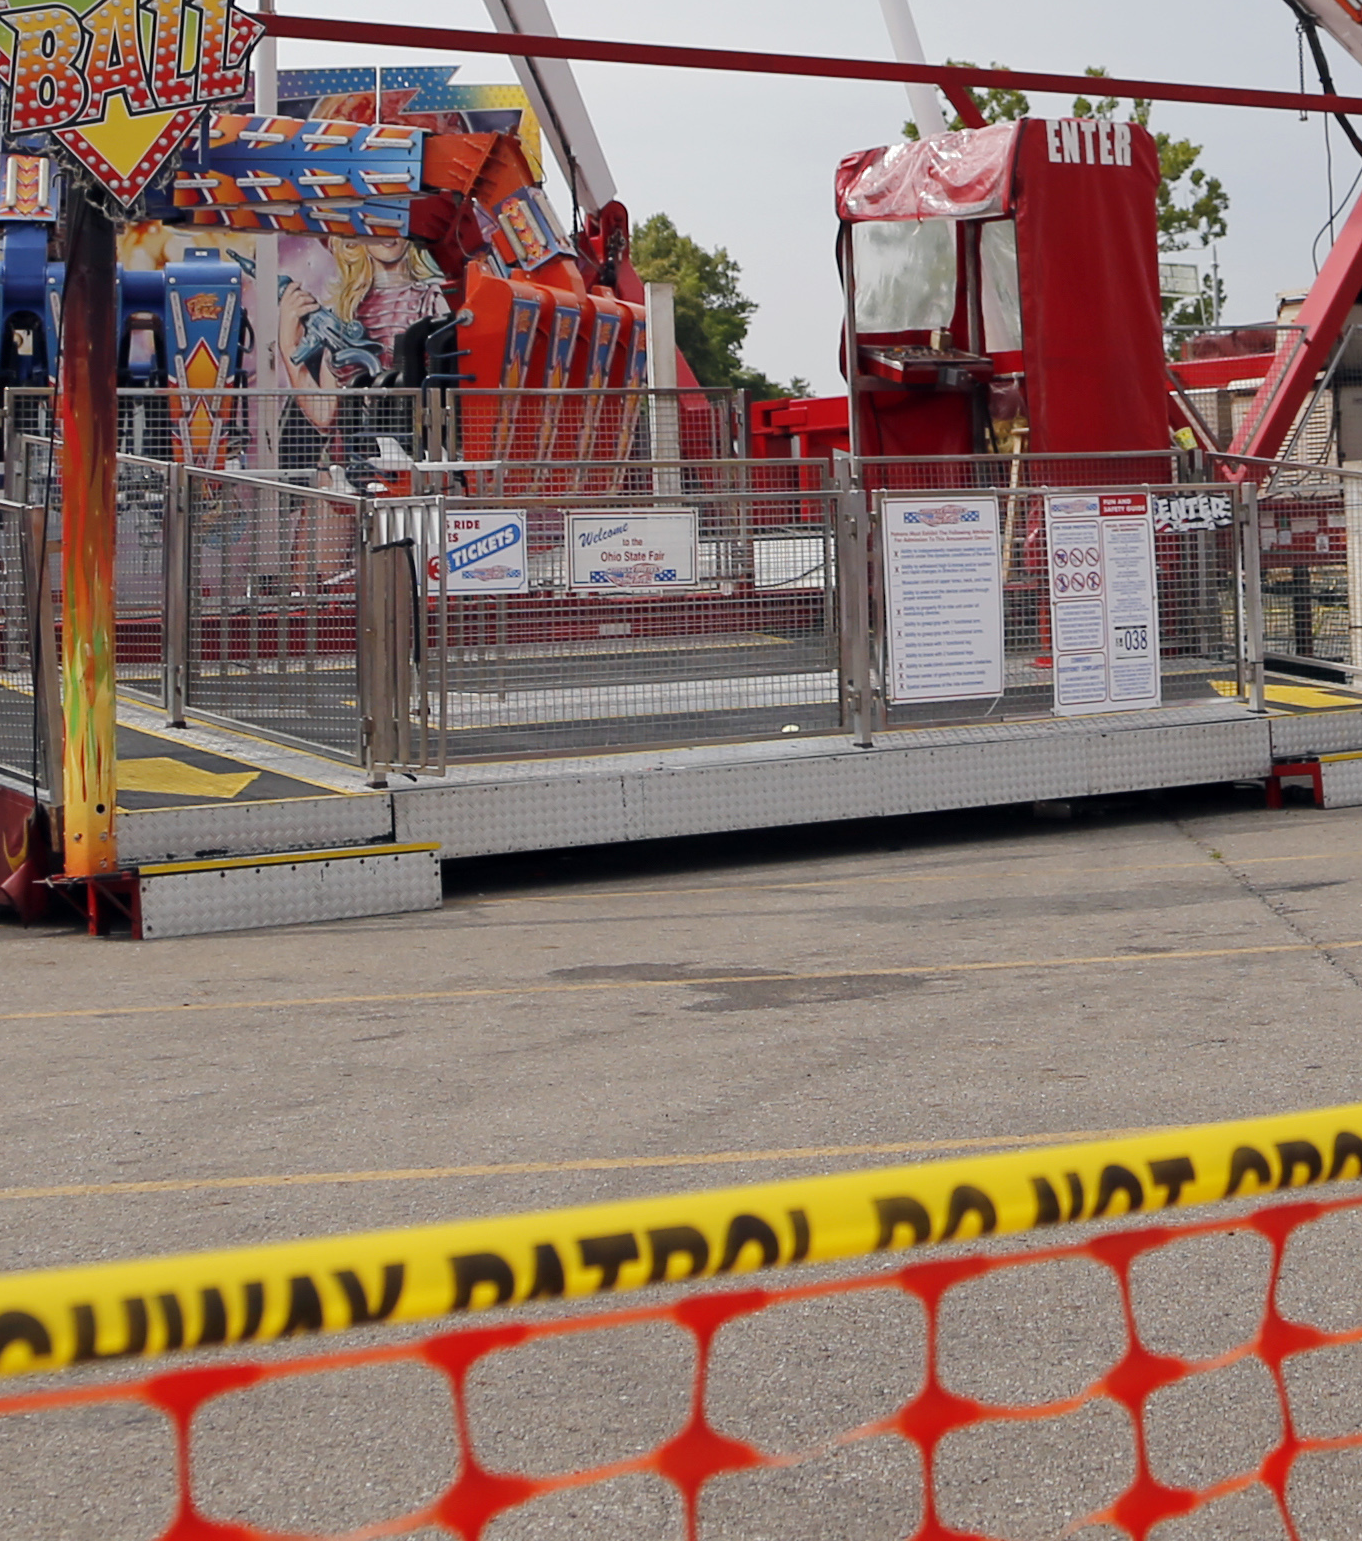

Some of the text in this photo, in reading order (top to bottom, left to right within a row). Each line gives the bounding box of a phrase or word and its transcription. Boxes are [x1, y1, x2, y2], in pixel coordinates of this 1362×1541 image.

[1046, 120, 1132, 166] ENTER
[1103, 505, 1125, 513] SAFETY
[1117, 497, 1132, 505] AND
[1157, 496, 1226, 520] ENTER
[454, 520, 480, 530] RIDE
[578, 522, 628, 547] Welcome
[622, 538, 643, 546] to the
[452, 527, 515, 567] TICKETS
[601, 550, 665, 562] Ohio State Fair
[1125, 629, 1148, 650] 038
